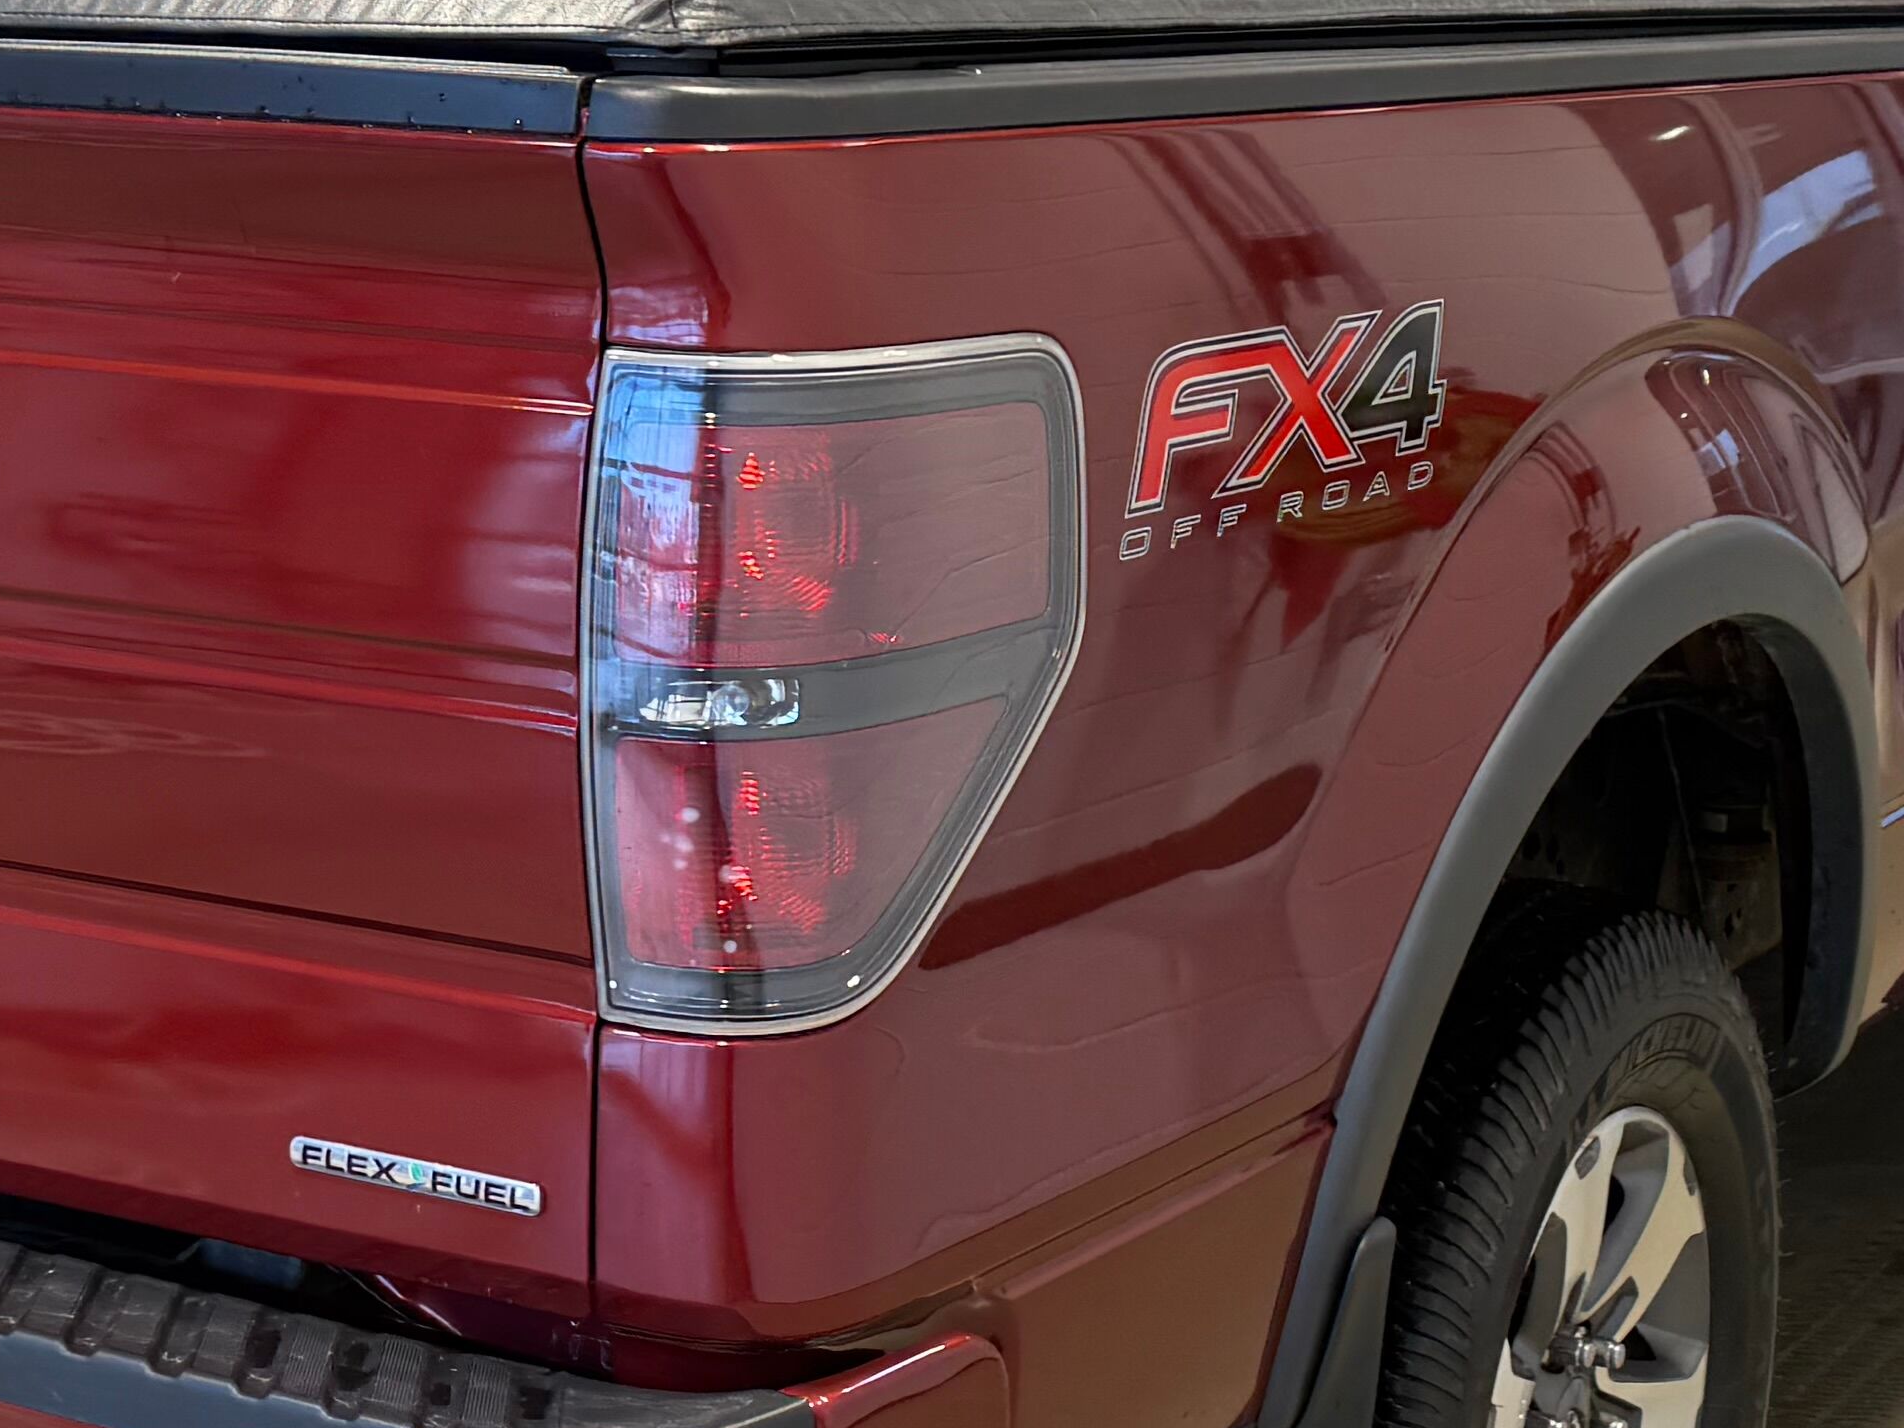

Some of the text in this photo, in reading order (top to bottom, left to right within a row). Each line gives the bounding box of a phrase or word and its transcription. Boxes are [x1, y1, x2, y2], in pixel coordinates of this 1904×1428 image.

[1125, 298, 1448, 519] FX4
[1119, 460, 1435, 561] OFF ROAD
[301, 1144, 532, 1211] FLEX FUEL
